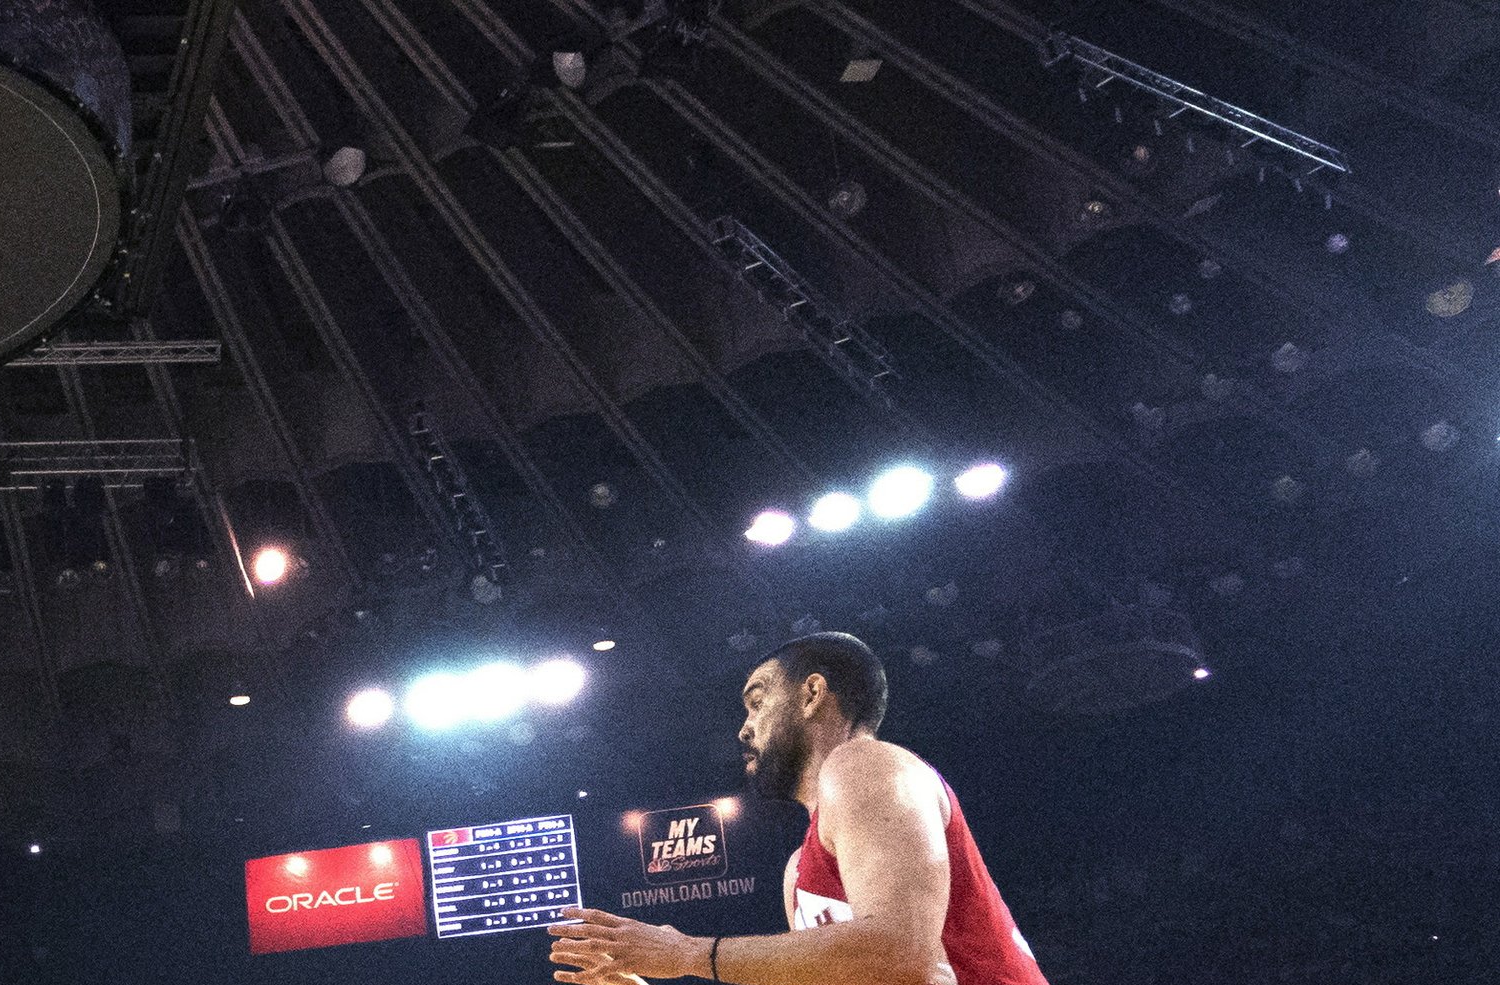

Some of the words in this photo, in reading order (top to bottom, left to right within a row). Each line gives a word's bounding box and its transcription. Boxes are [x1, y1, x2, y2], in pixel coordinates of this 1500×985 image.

[668, 818, 699, 839] MY
[651, 835, 716, 862] TEAMS
[265, 882, 395, 913] ORACLE
[622, 882, 712, 909] DOWNLOAD
[717, 877, 755, 897] NOW
